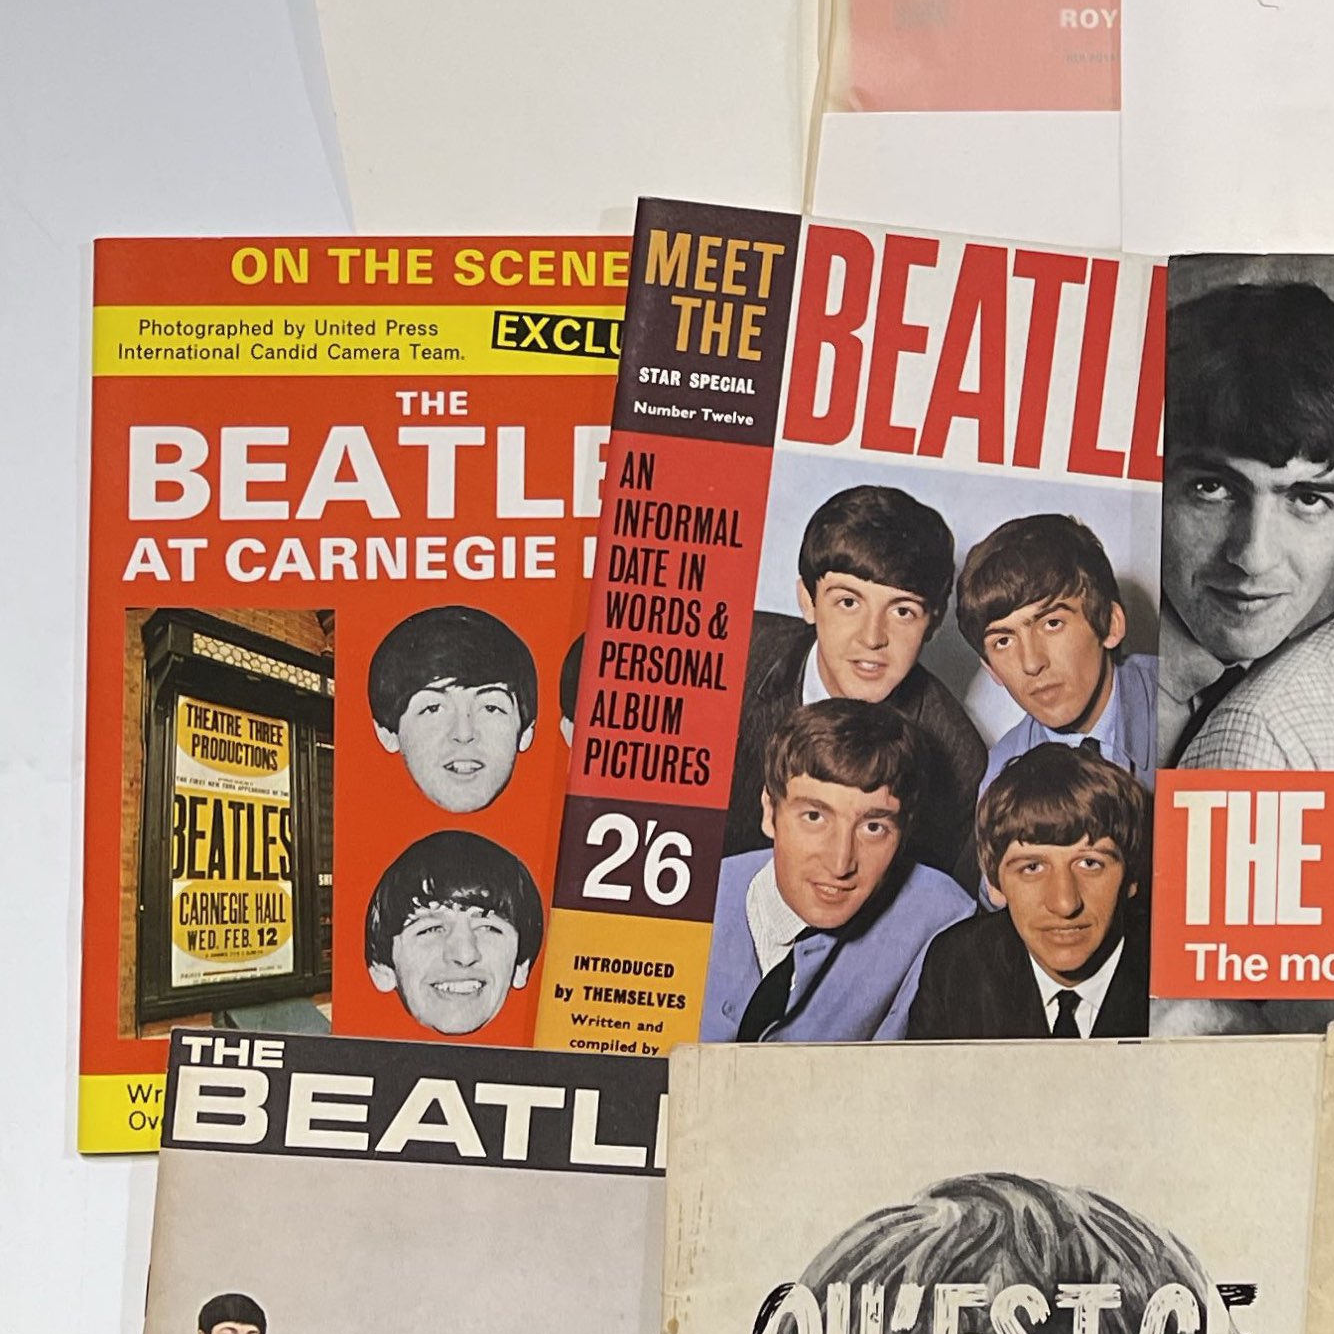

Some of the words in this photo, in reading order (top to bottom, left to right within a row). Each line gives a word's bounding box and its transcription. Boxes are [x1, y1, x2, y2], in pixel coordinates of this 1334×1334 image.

[643, 228, 785, 300] MEET
[138, 319, 273, 339] Photographed
[284, 320, 305, 339] by
[314, 319, 375, 337] United
[386, 321, 439, 337] Press
[671, 294, 764, 362] THE
[118, 343, 240, 360] International
[250, 343, 318, 360] Candid
[328, 344, 400, 360] Camera
[409, 344, 465, 361] Team.
[638, 366, 682, 388] STAR
[689, 373, 756, 395] SPECIAL
[395, 390, 468, 416] THE
[633, 401, 697, 422] Number
[701, 406, 754, 427] Twelve
[122, 537, 208, 583] AT
[225, 535, 556, 581] CARNEGIE
[171, 794, 293, 883] BEATLES
[1173, 790, 1325, 927] THE
[179, 889, 250, 928] CARNEGIE
[254, 894, 287, 925] HALL
[1184, 943, 1269, 983] The
